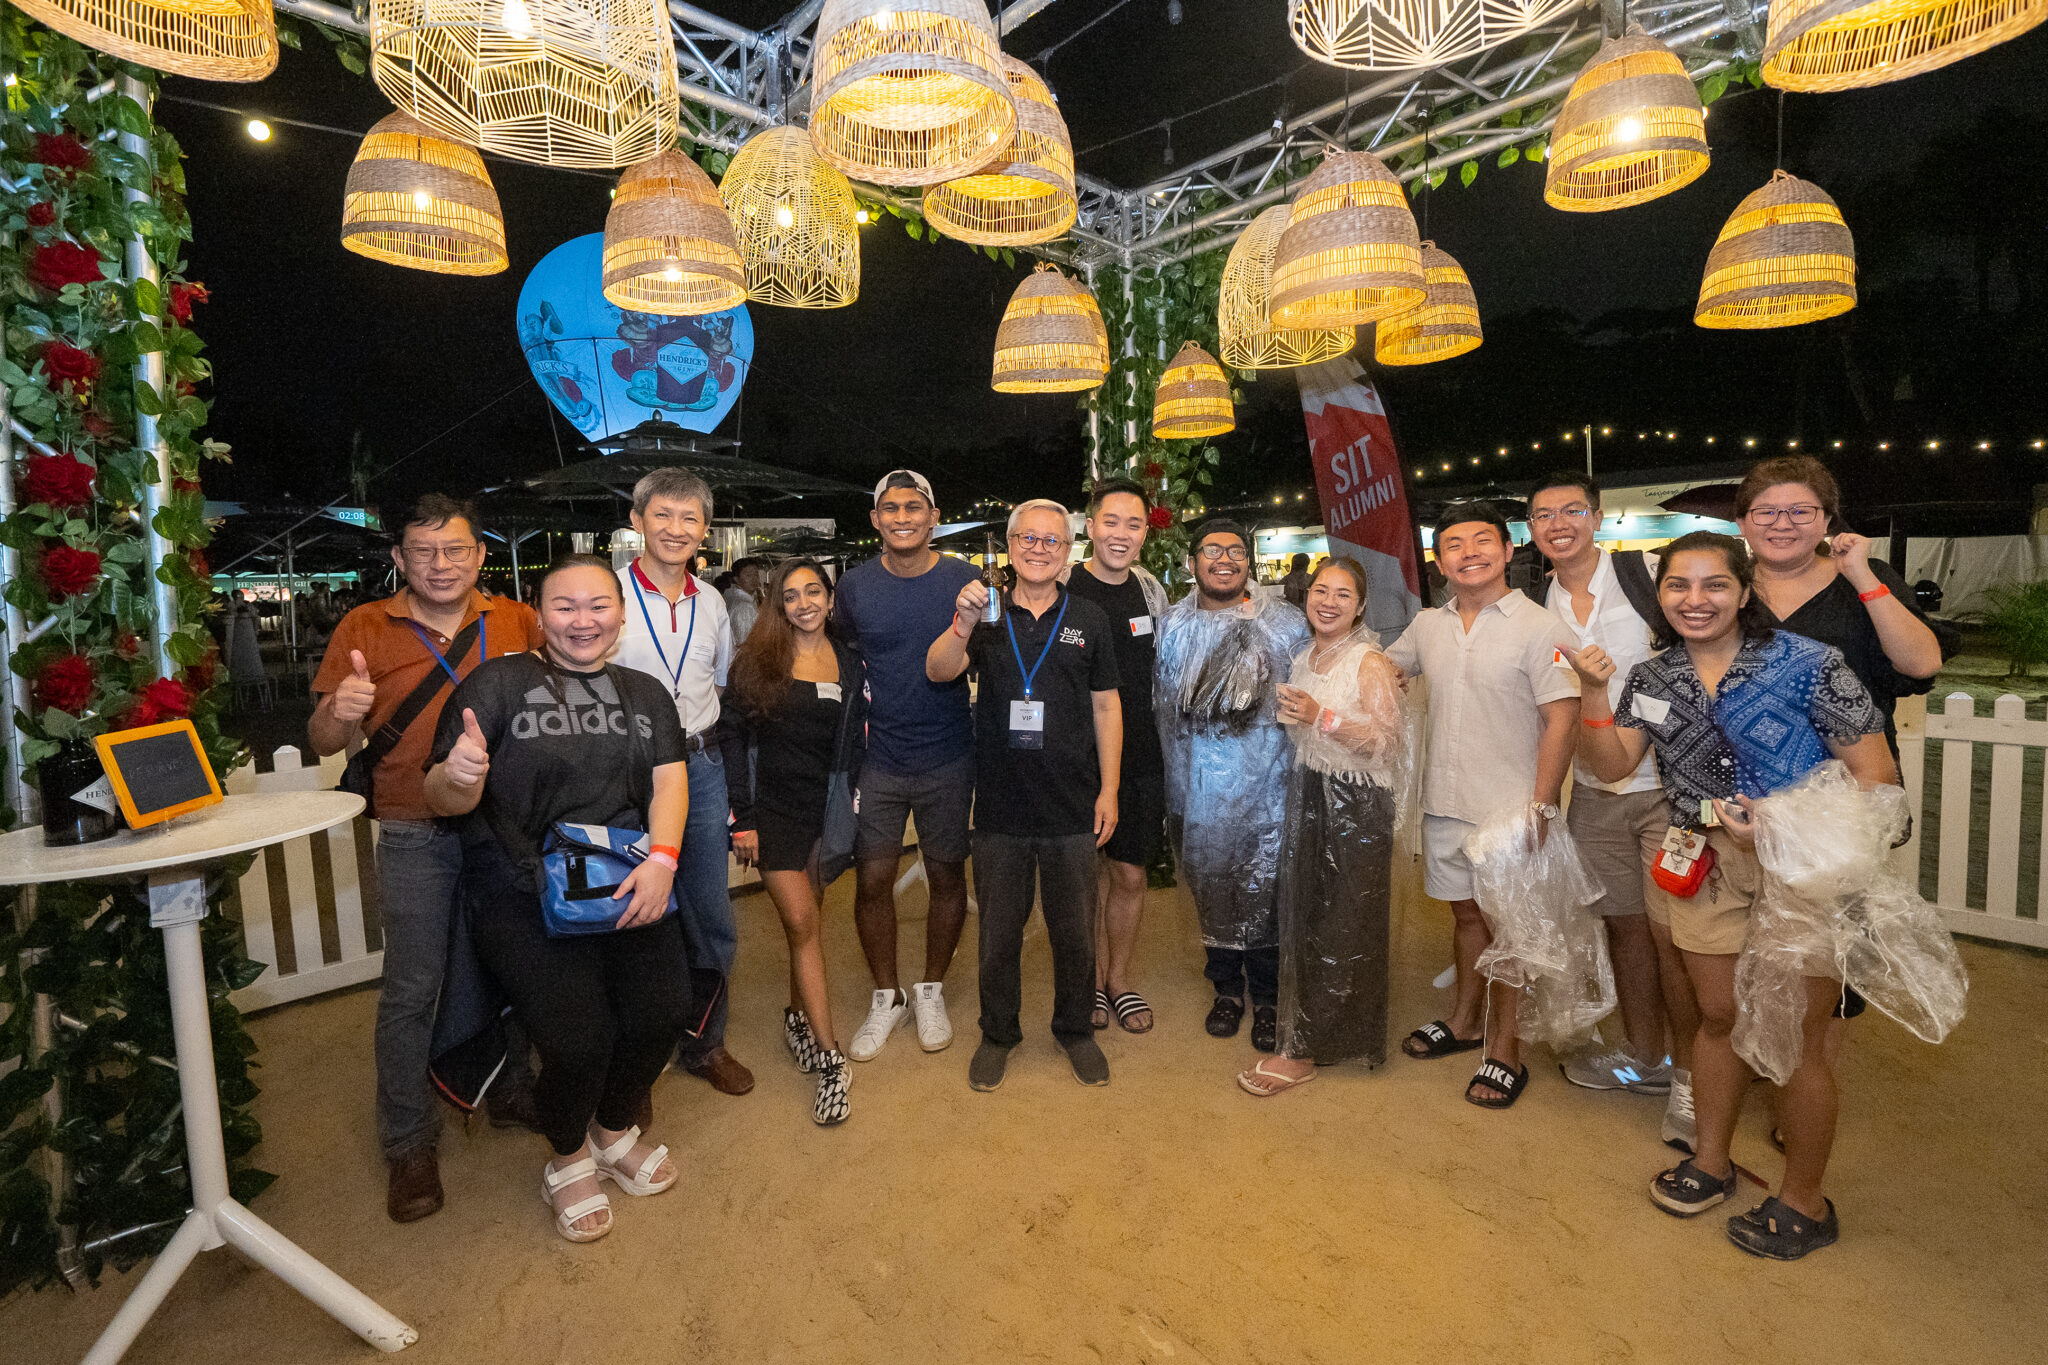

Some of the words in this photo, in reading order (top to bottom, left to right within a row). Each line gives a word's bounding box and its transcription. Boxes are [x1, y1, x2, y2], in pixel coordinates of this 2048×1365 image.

[1330, 434, 1373, 495] SIT
[338, 511, 366, 520] 02:08
[1330, 474, 1396, 533] ALUMNI
[1060, 632, 1085, 645] ZERO
[1064, 626, 1083, 637] DAY
[511, 703, 653, 740] adidas
[1475, 1063, 1515, 1090] NIKE
